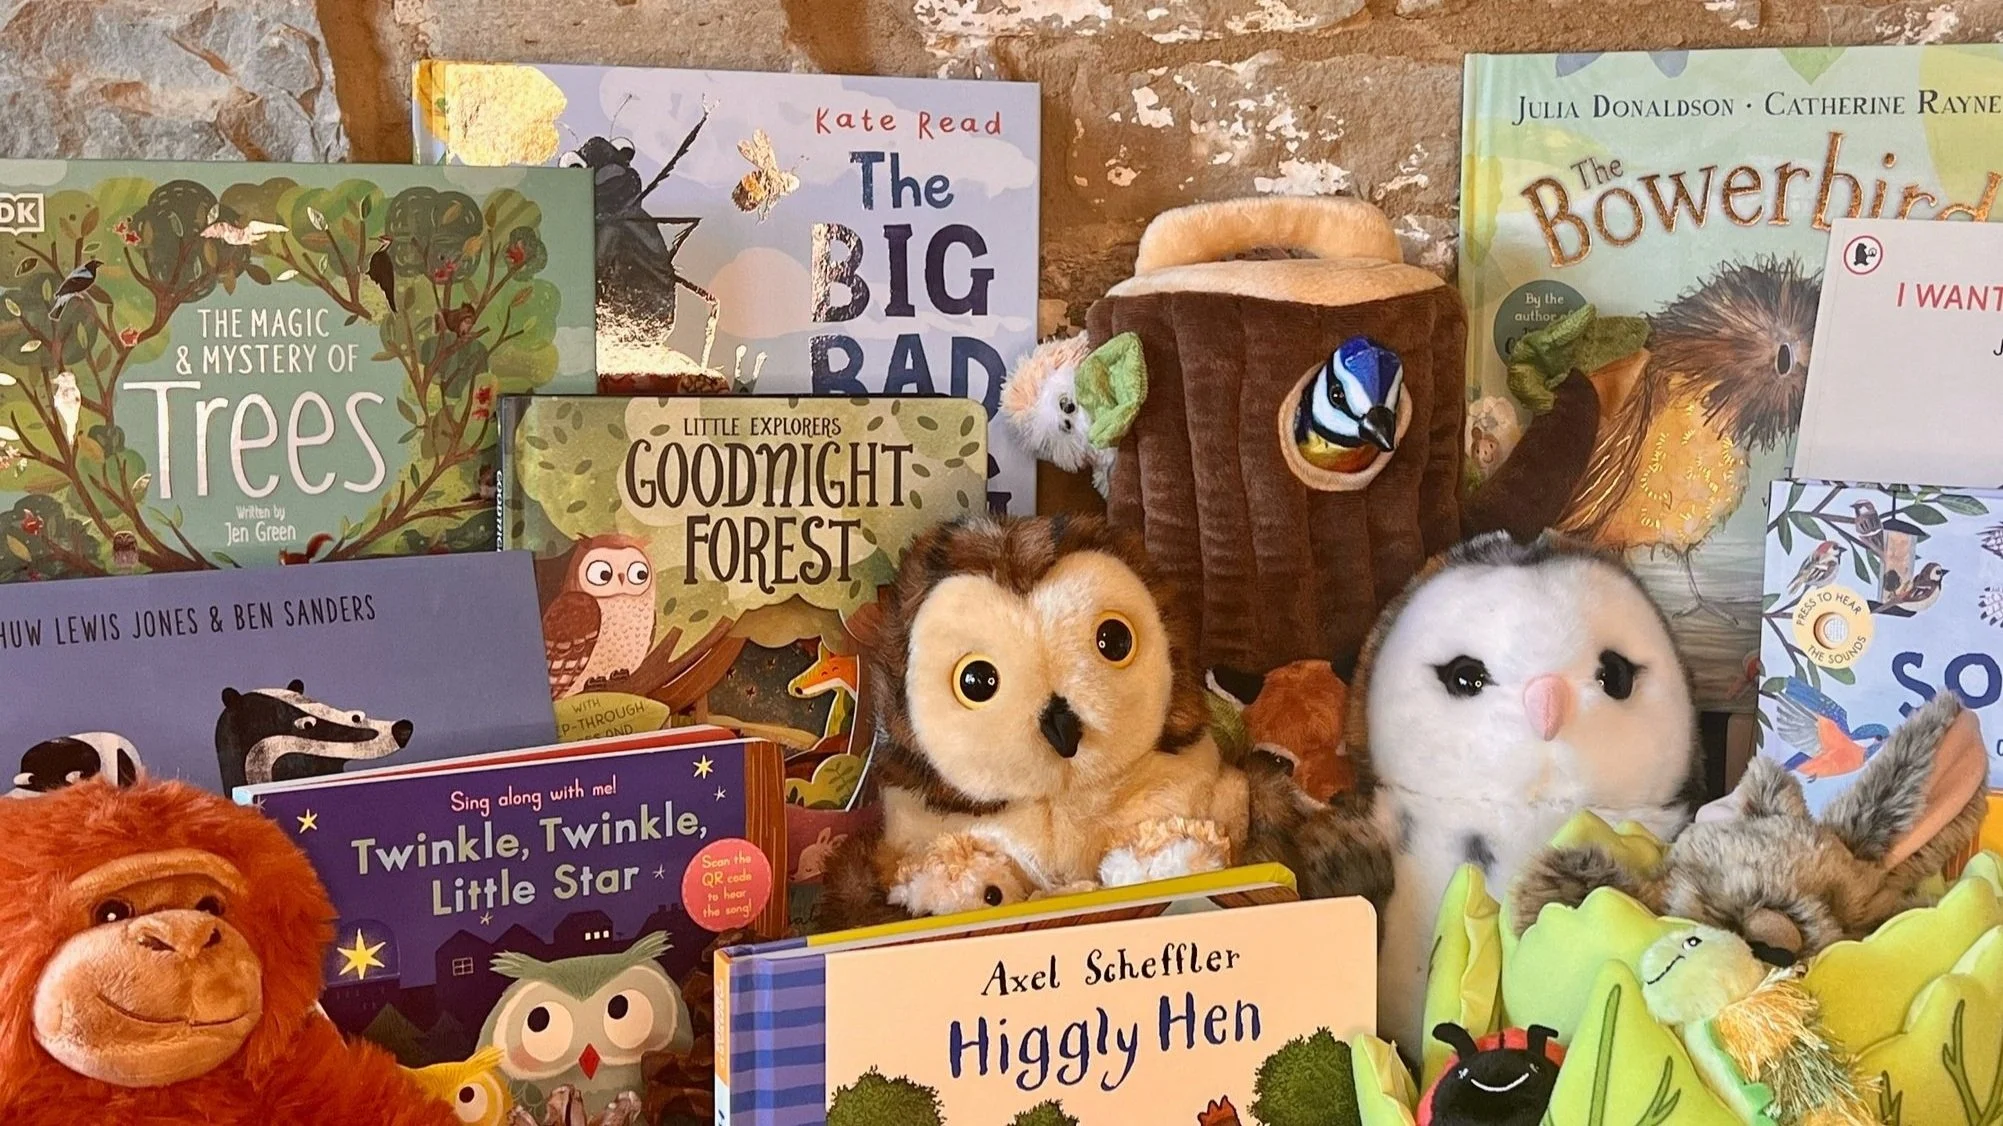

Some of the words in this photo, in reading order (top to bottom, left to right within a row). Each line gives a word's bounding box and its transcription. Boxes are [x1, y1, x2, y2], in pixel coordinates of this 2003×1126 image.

[815, 107, 897, 136] Kate
[918, 111, 1002, 139] Read
[1512, 95, 1580, 126] JULIA
[1593, 94, 1734, 118] DONALDSON
[1764, 91, 1906, 116] CATHERINE
[849, 151, 954, 210] The
[1570, 156, 1624, 190] The
[0, 202, 37, 224] DK
[811, 223, 995, 322] BIG
[1525, 292, 1541, 308] By
[1545, 292, 1564, 305] the
[1897, 282, 1905, 307] I
[1916, 283, 2003, 312] WANT
[198, 309, 247, 340] THE
[251, 308, 330, 339] MAGIC
[1514, 310, 1557, 321] author
[176, 346, 193, 374] &
[202, 345, 316, 373] MYSTERY
[328, 344, 359, 372] OF
[810, 333, 1004, 422] BAD
[123, 380, 388, 500] Trees
[684, 417, 740, 436] LITTLE
[750, 417, 842, 438] EXPLORERS
[624, 439, 913, 509] GOODNIGHT
[236, 506, 269, 520] Written
[272, 506, 285, 523] by
[226, 522, 250, 544] Jen
[255, 522, 297, 542] Green
[684, 514, 861, 594] FOREST
[55, 613, 120, 645] LEWIS
[132, 608, 198, 639] JONES
[209, 605, 224, 633] &
[235, 601, 274, 630] BEN
[284, 594, 377, 627] SANDERS
[1796, 598, 1817, 626] PRESS
[1817, 591, 1832, 602] TO
[1835, 592, 1862, 615] HEAR
[1807, 644, 1825, 662] THE
[1828, 635, 1866, 664] SOUNDS
[572, 698, 601, 714] WITH
[450, 789, 491, 816] Sing
[498, 784, 542, 812] along
[550, 779, 586, 801] with
[592, 775, 618, 796] me!
[351, 820, 531, 875] Twinkle,
[539, 800, 709, 853] Twinkle,
[702, 855, 730, 869] Scan
[734, 851, 752, 864] the
[432, 864, 536, 916] Little
[554, 862, 640, 900] Star
[702, 872, 724, 888] QR
[727, 868, 752, 884] code
[702, 904, 720, 918] the
[726, 898, 752, 918] song!
[707, 893, 719, 902] to
[724, 887, 746, 900] hear
[981, 955, 1061, 997] Axel
[1085, 945, 1241, 986] Scheffler
[948, 1007, 1139, 1092] Higgly
[1157, 991, 1261, 1051] Hen
